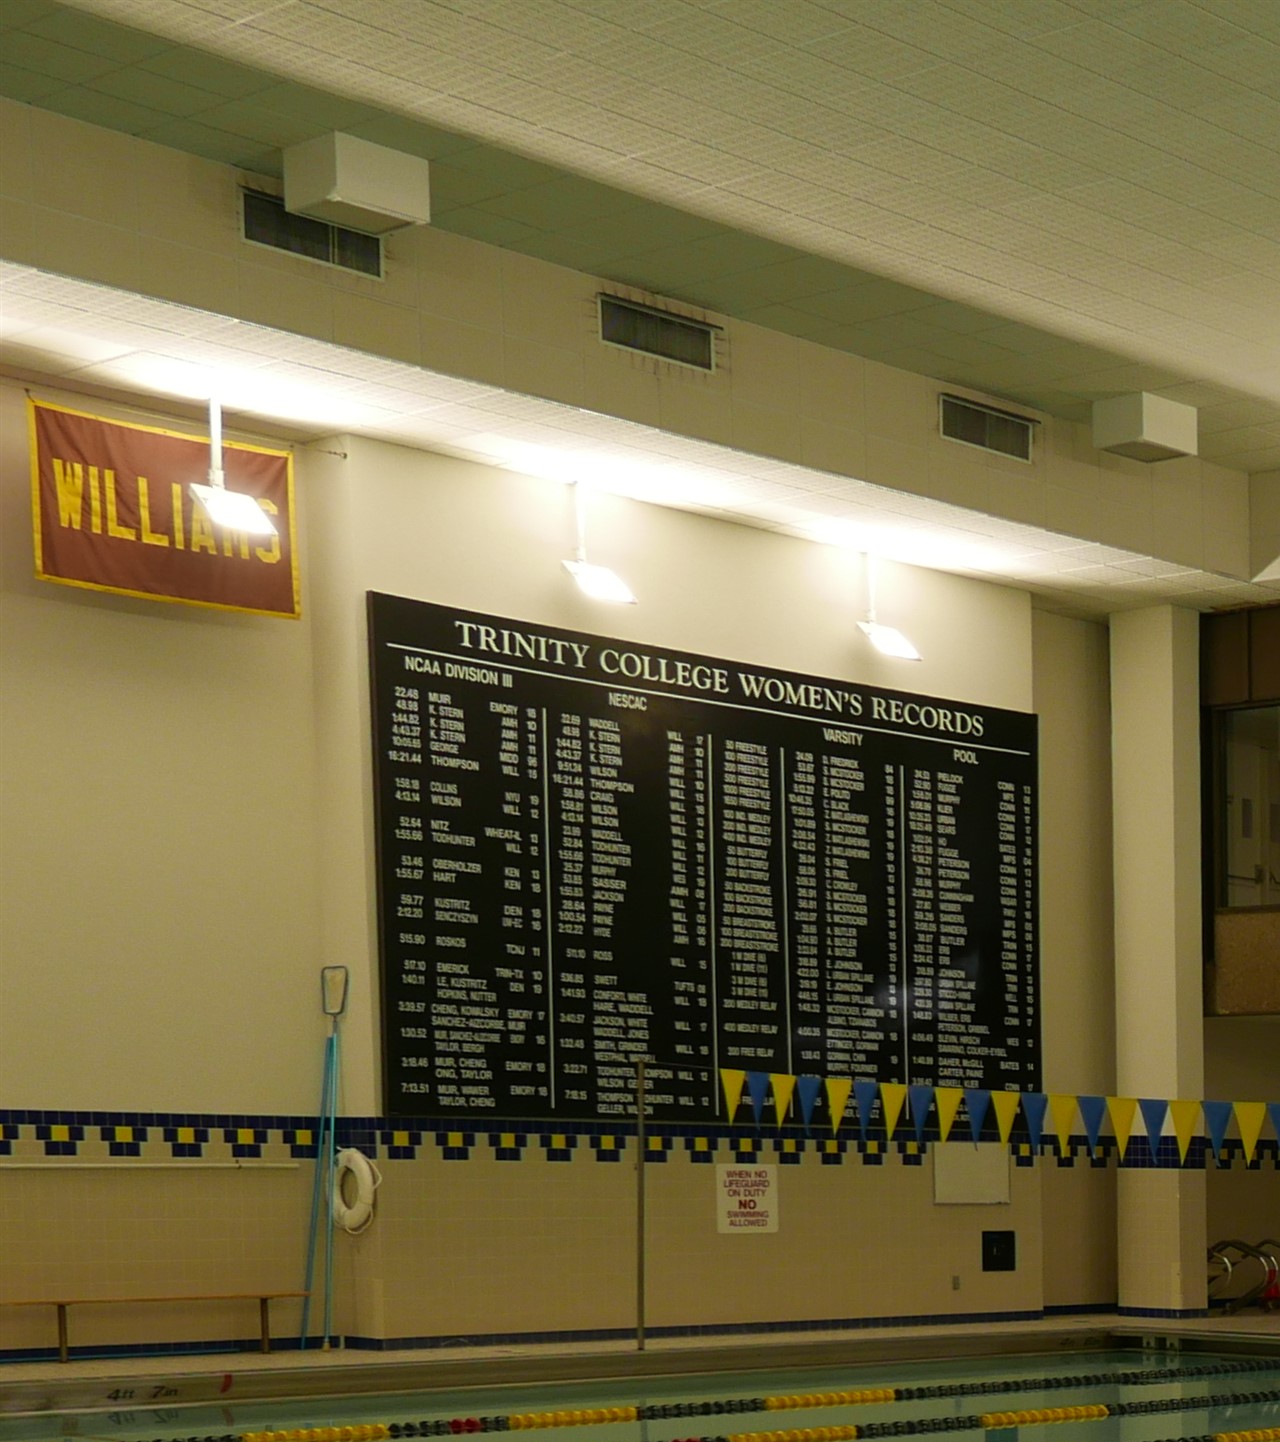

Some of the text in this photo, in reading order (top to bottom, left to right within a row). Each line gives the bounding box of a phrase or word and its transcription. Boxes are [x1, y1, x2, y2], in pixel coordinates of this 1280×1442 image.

[405, 656, 513, 687] NCAA DIVISION III
[455, 620, 984, 737] TRINITY COLLEGE WOMEN'S RECORDS
[609, 692, 648, 711] NESCAC
[823, 728, 863, 746] VARSITY
[954, 749, 979, 765] POOL
[431, 755, 479, 771] THOMPSON
[431, 794, 462, 807] WILSON
[433, 872, 456, 883] HART
[507, 1009, 533, 1019] EMORY
[459, 1058, 487, 1069] CHENG
[461, 1070, 492, 1080] TAYLOR
[470, 1097, 496, 1107] CHENG
[755, 1170, 767, 1178] NO
[724, 1180, 769, 1188] LIFEGUARD
[728, 1189, 766, 1197] ON DUTY
[739, 1200, 756, 1209] NO
